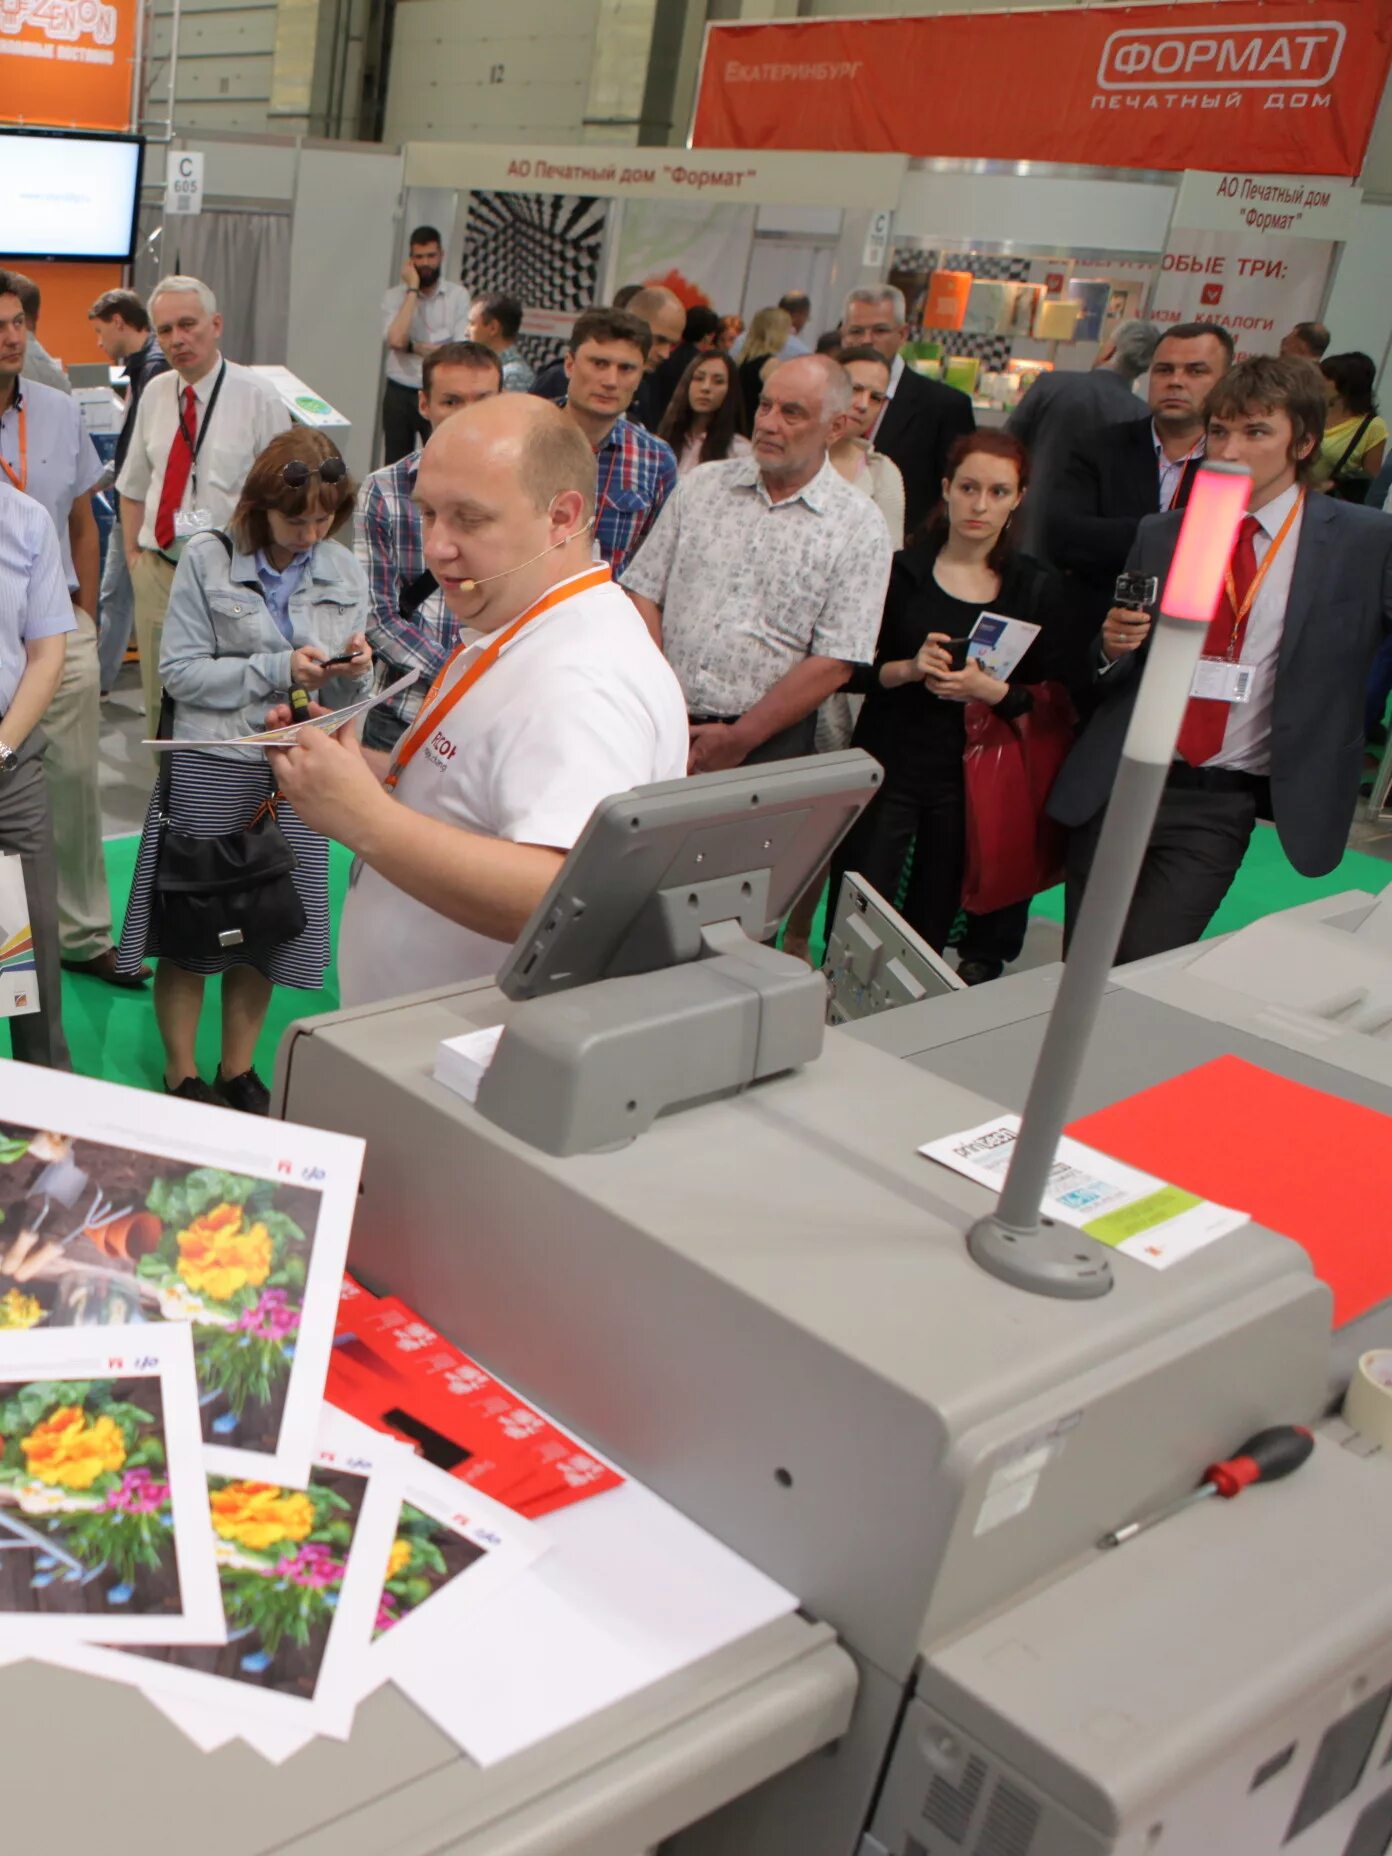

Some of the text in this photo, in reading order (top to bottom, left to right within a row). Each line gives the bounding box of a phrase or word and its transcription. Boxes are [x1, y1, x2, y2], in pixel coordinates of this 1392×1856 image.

[1113, 35, 1329, 75] ФОРМАТ
[489, 64, 506, 85] 12
[1090, 91, 1332, 110] ПЕЧАТНЫЙ ДОМ
[179, 158, 193, 178] C
[508, 160, 531, 177] АО
[535, 161, 616, 181] Печатный
[619, 168, 656, 185] дом
[174, 180, 198, 194] 605
[1217, 176, 1331, 208] АО Печатный дом
[1237, 258, 1289, 279] ТРИ:
